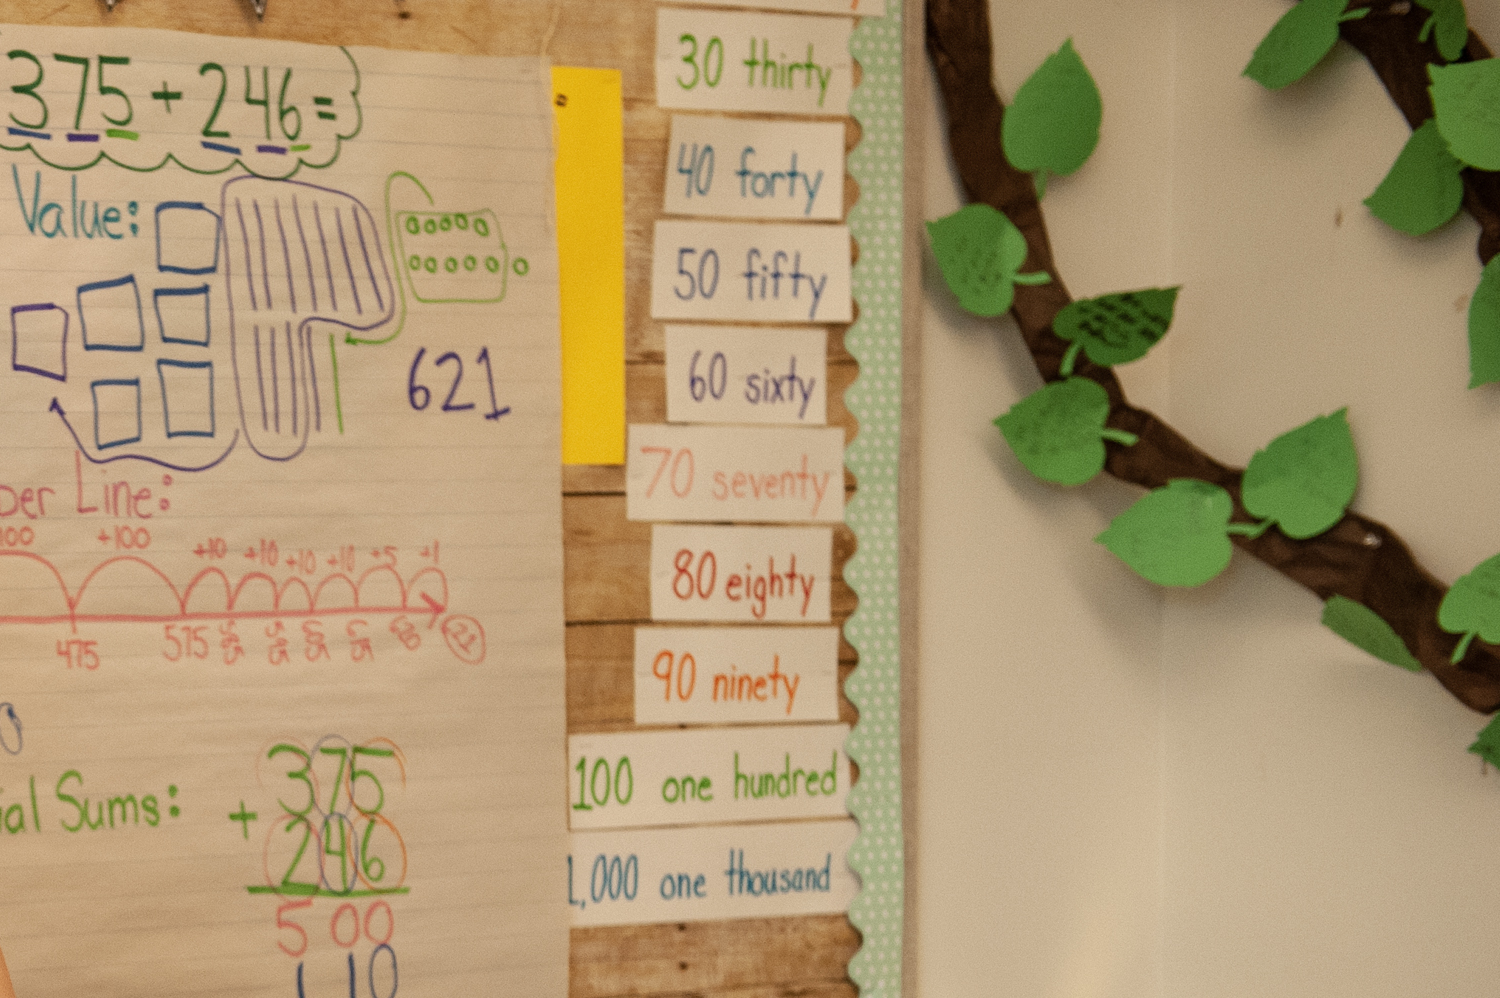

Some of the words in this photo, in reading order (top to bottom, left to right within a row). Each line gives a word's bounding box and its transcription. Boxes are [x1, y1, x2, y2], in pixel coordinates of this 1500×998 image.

[676, 34, 724, 90] 30
[744, 37, 831, 107] thirty
[12, 163, 139, 239] Value:
[677, 142, 715, 198] 40
[735, 146, 824, 216] forty
[674, 247, 720, 301] 50
[742, 247, 828, 320] fifty
[407, 346, 511, 421] 621
[689, 350, 728, 402] 60
[745, 355, 816, 419] sixty
[76, 449, 172, 515] Line:
[640, 446, 696, 499] 70
[713, 454, 830, 518] seventy
[98, 525, 151, 549] +100
[672, 548, 717, 601] 80
[726, 553, 815, 619] eighty
[56, 639, 100, 670] 475
[163, 624, 209, 662] 575
[652, 649, 697, 702] 90
[713, 654, 800, 715] ninety
[56, 769, 180, 833] Sums:
[267, 744, 394, 817] 375
[572, 755, 634, 811] 100
[662, 774, 714, 803] one
[734, 750, 838, 800] hundred
[281, 815, 385, 893] 246
[660, 872, 707, 900] one
[725, 848, 832, 896] thousand
[277, 900, 394, 957] 500
